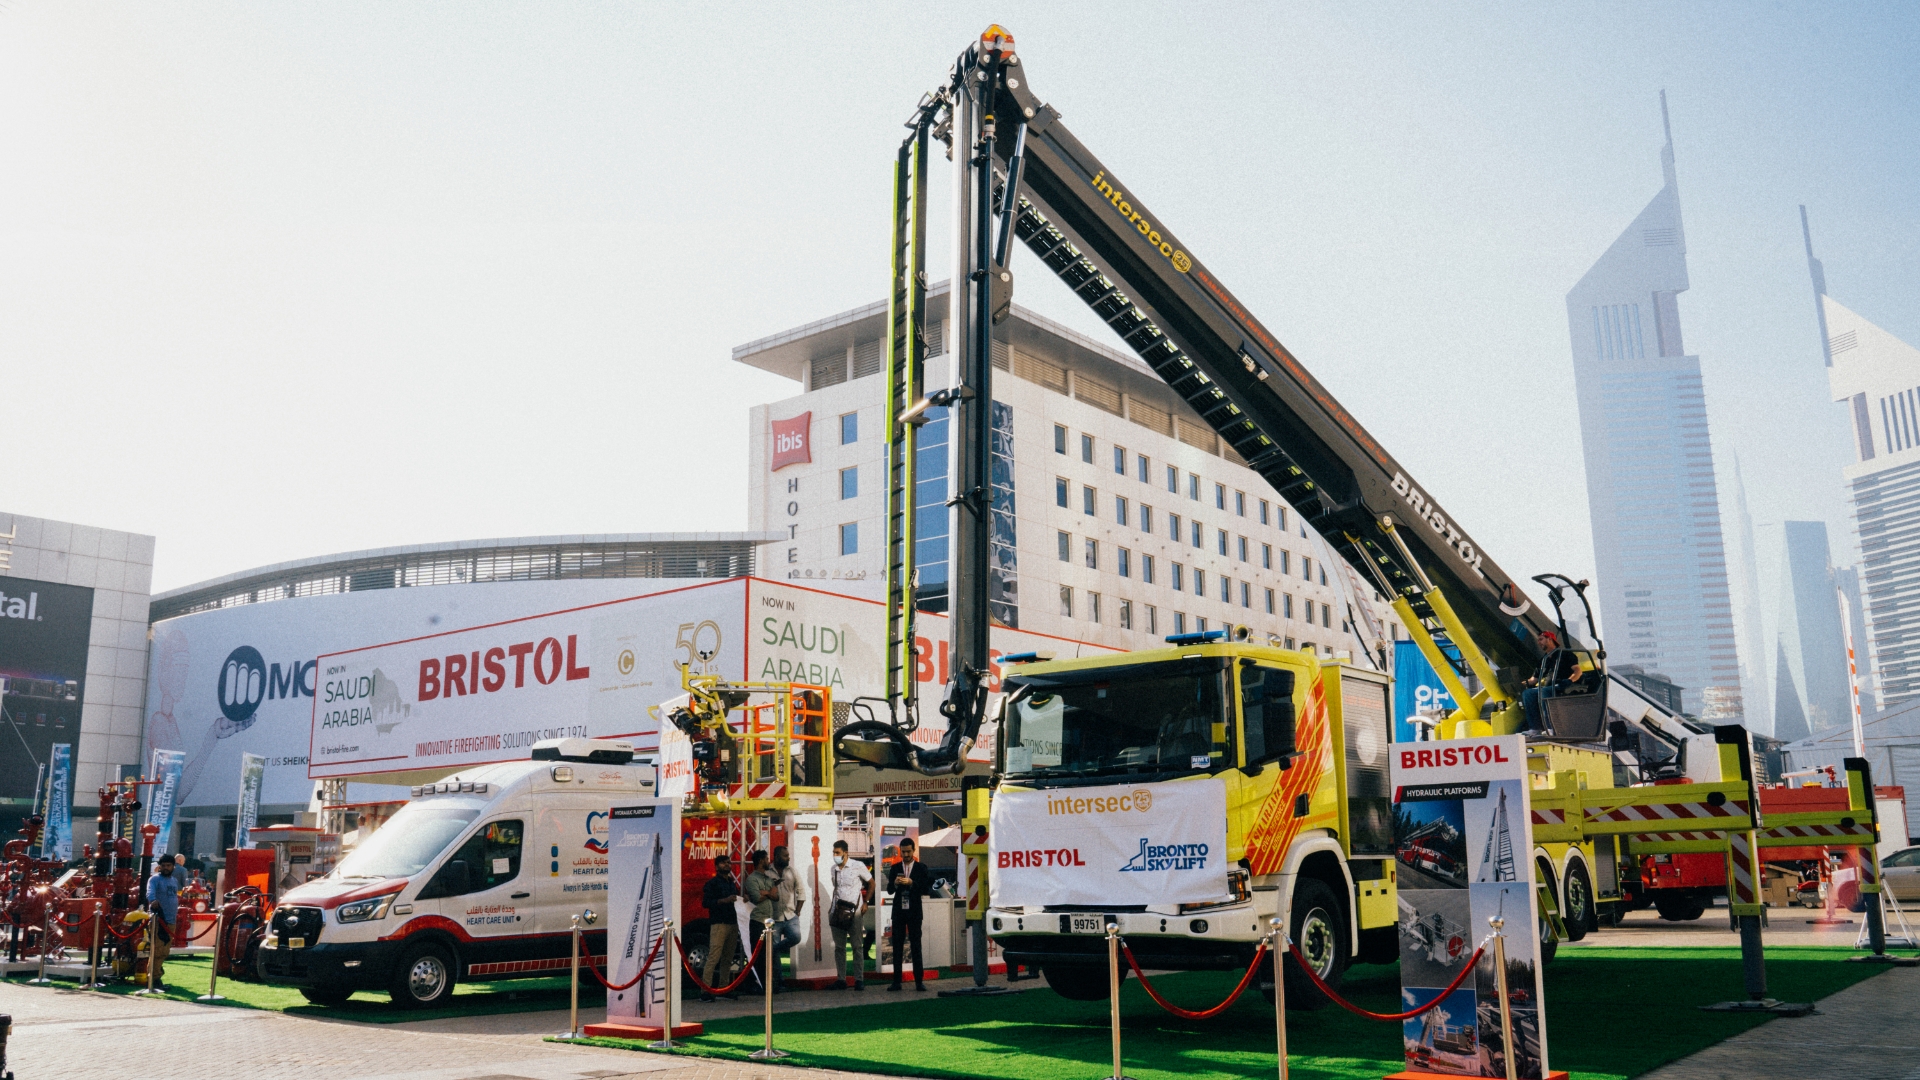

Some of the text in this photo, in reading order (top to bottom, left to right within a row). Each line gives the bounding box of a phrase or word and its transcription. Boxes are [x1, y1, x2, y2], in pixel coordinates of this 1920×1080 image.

[1092, 170, 1172, 257] intersec
[778, 431, 803, 454] ibis
[788, 477, 798, 579] HOTE
[1390, 471, 1484, 579] BRISTOL
[762, 596, 795, 612] NOW IN
[673, 620, 722, 672] 50
[763, 617, 844, 656] SAUDI
[326, 665, 346, 676] NOW IN
[418, 634, 590, 702] BRISTOL
[762, 657, 844, 689] ARABIA
[324, 674, 376, 703] SAUDI
[322, 707, 372, 729] ARABIA
[416, 740, 452, 757] INNOVATIVE
[454, 734, 500, 753] FIREFIGHTING
[502, 730, 542, 749] SOLUTIONS
[568, 726, 588, 739] 1974
[272, 757, 282, 766] US
[1401, 744, 1508, 769] BRISTOL
[873, 781, 906, 792] INNOVATIVE
[908, 778, 948, 790] FIREFIGHTING
[1406, 786, 1482, 798] HYDRAULIC PLATFORMS
[152, 790, 163, 826] OSTERING
[160, 772, 176, 830] PROTECTION
[1048, 794, 1132, 816] intersec
[1136, 792, 1150, 803] 25
[998, 848, 1086, 868] BRISTOL
[1148, 844, 1209, 858] BRONTO
[1148, 857, 1206, 871] SKYLIFT
[563, 884, 577, 893] Always
[467, 916, 515, 925] HEART CARE UNIT
[1074, 919, 1100, 930] 99751
[626, 924, 638, 958] BRONTO
